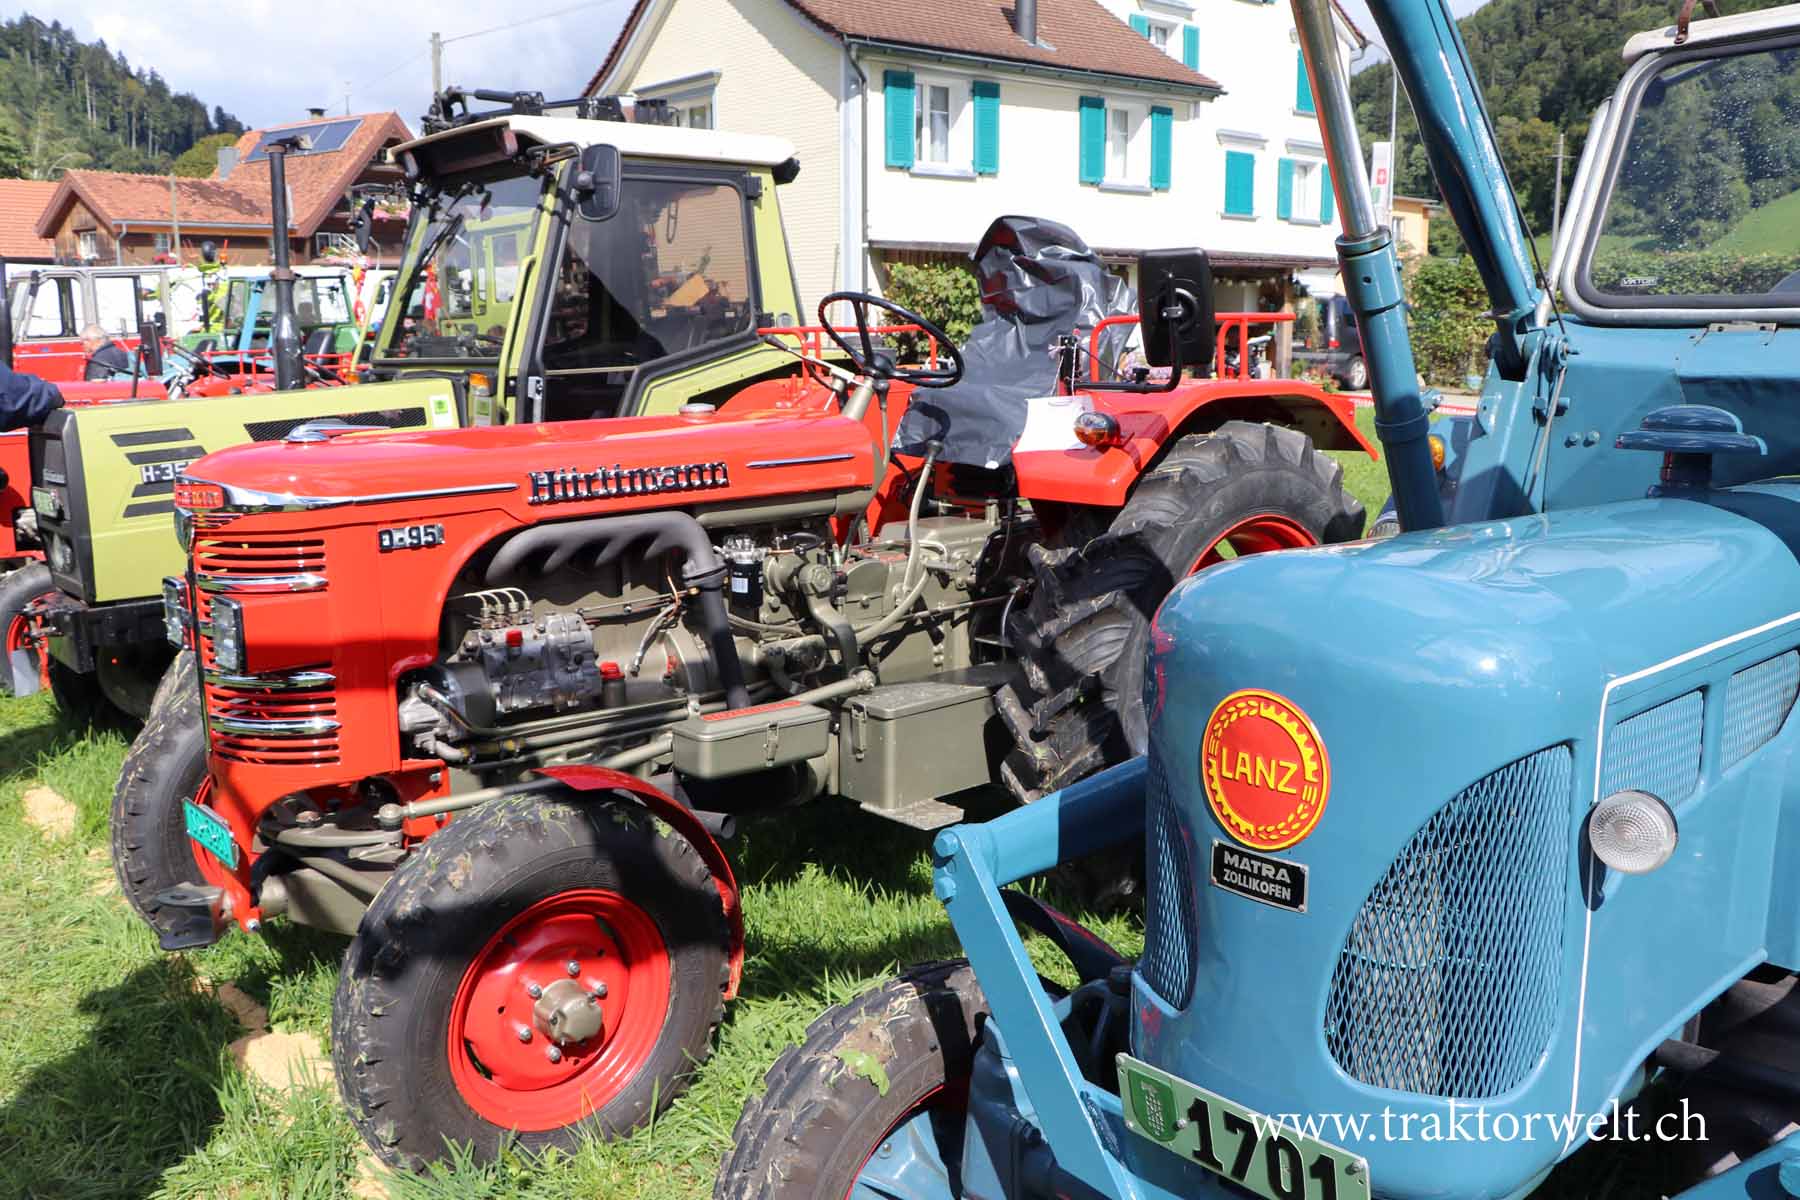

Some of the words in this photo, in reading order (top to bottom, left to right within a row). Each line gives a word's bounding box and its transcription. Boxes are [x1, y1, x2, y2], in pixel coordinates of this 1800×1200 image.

[1220, 746, 1299, 795] LANZ
[1222, 850, 1292, 884] MATRA
[1222, 868, 1292, 901] ZOLLIKOFEN
[1187, 1097, 1339, 1200] 1701
